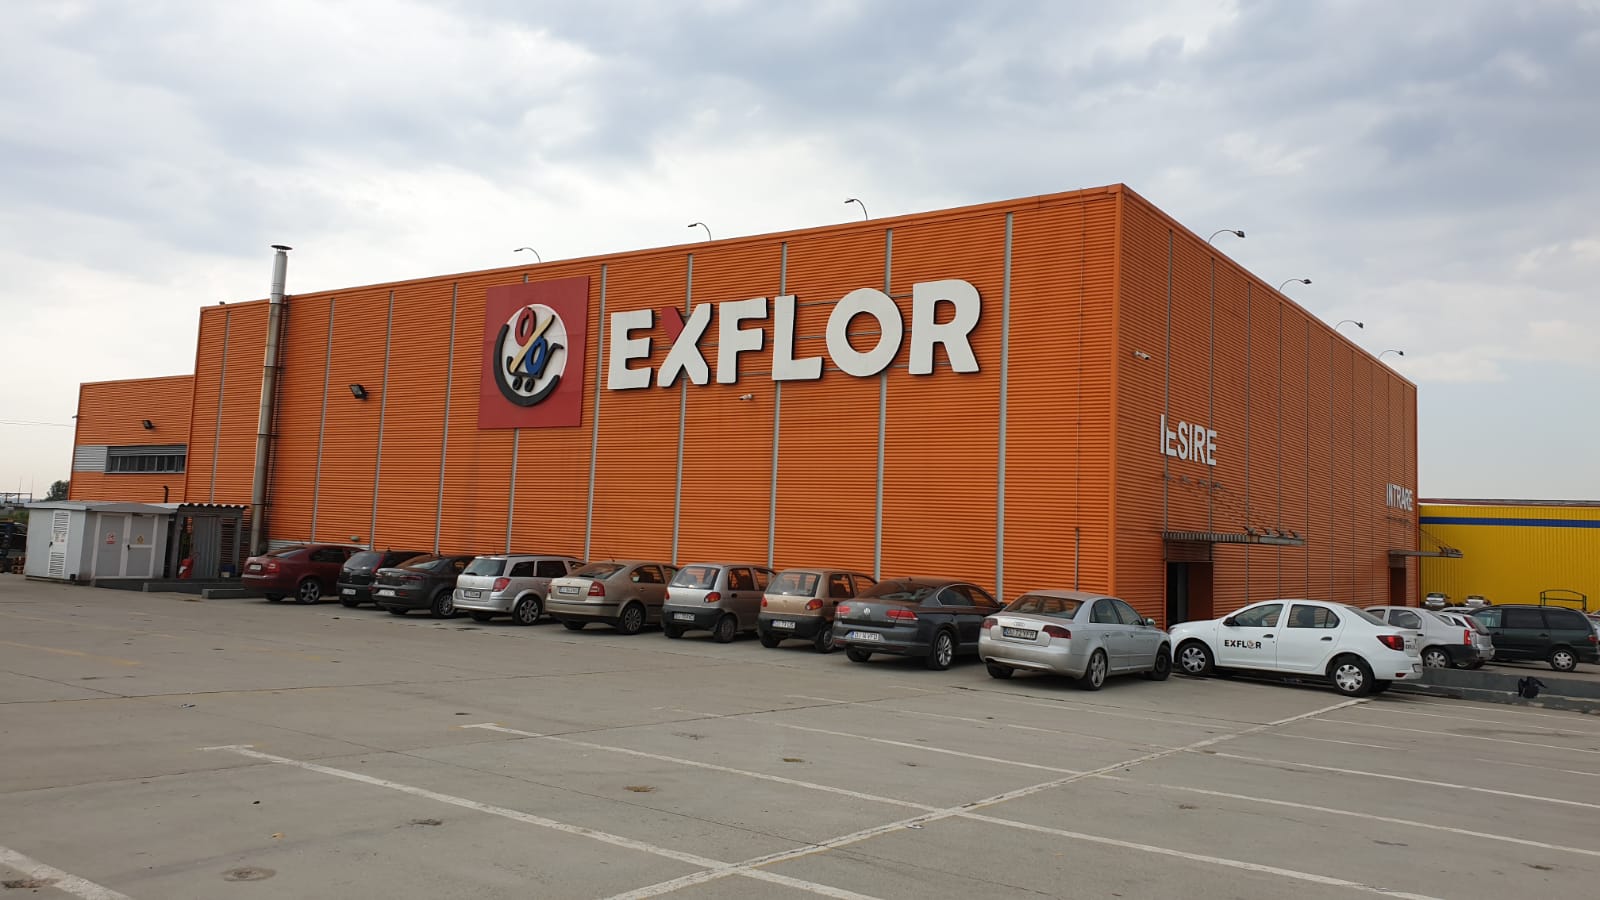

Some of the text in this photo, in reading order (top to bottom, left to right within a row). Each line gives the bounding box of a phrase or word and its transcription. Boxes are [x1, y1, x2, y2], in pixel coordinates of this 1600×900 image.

[607, 279, 981, 390] EXFLOR
[1386, 482, 1413, 511] INTRARE
[1224, 639, 1262, 649] EXFLOR
